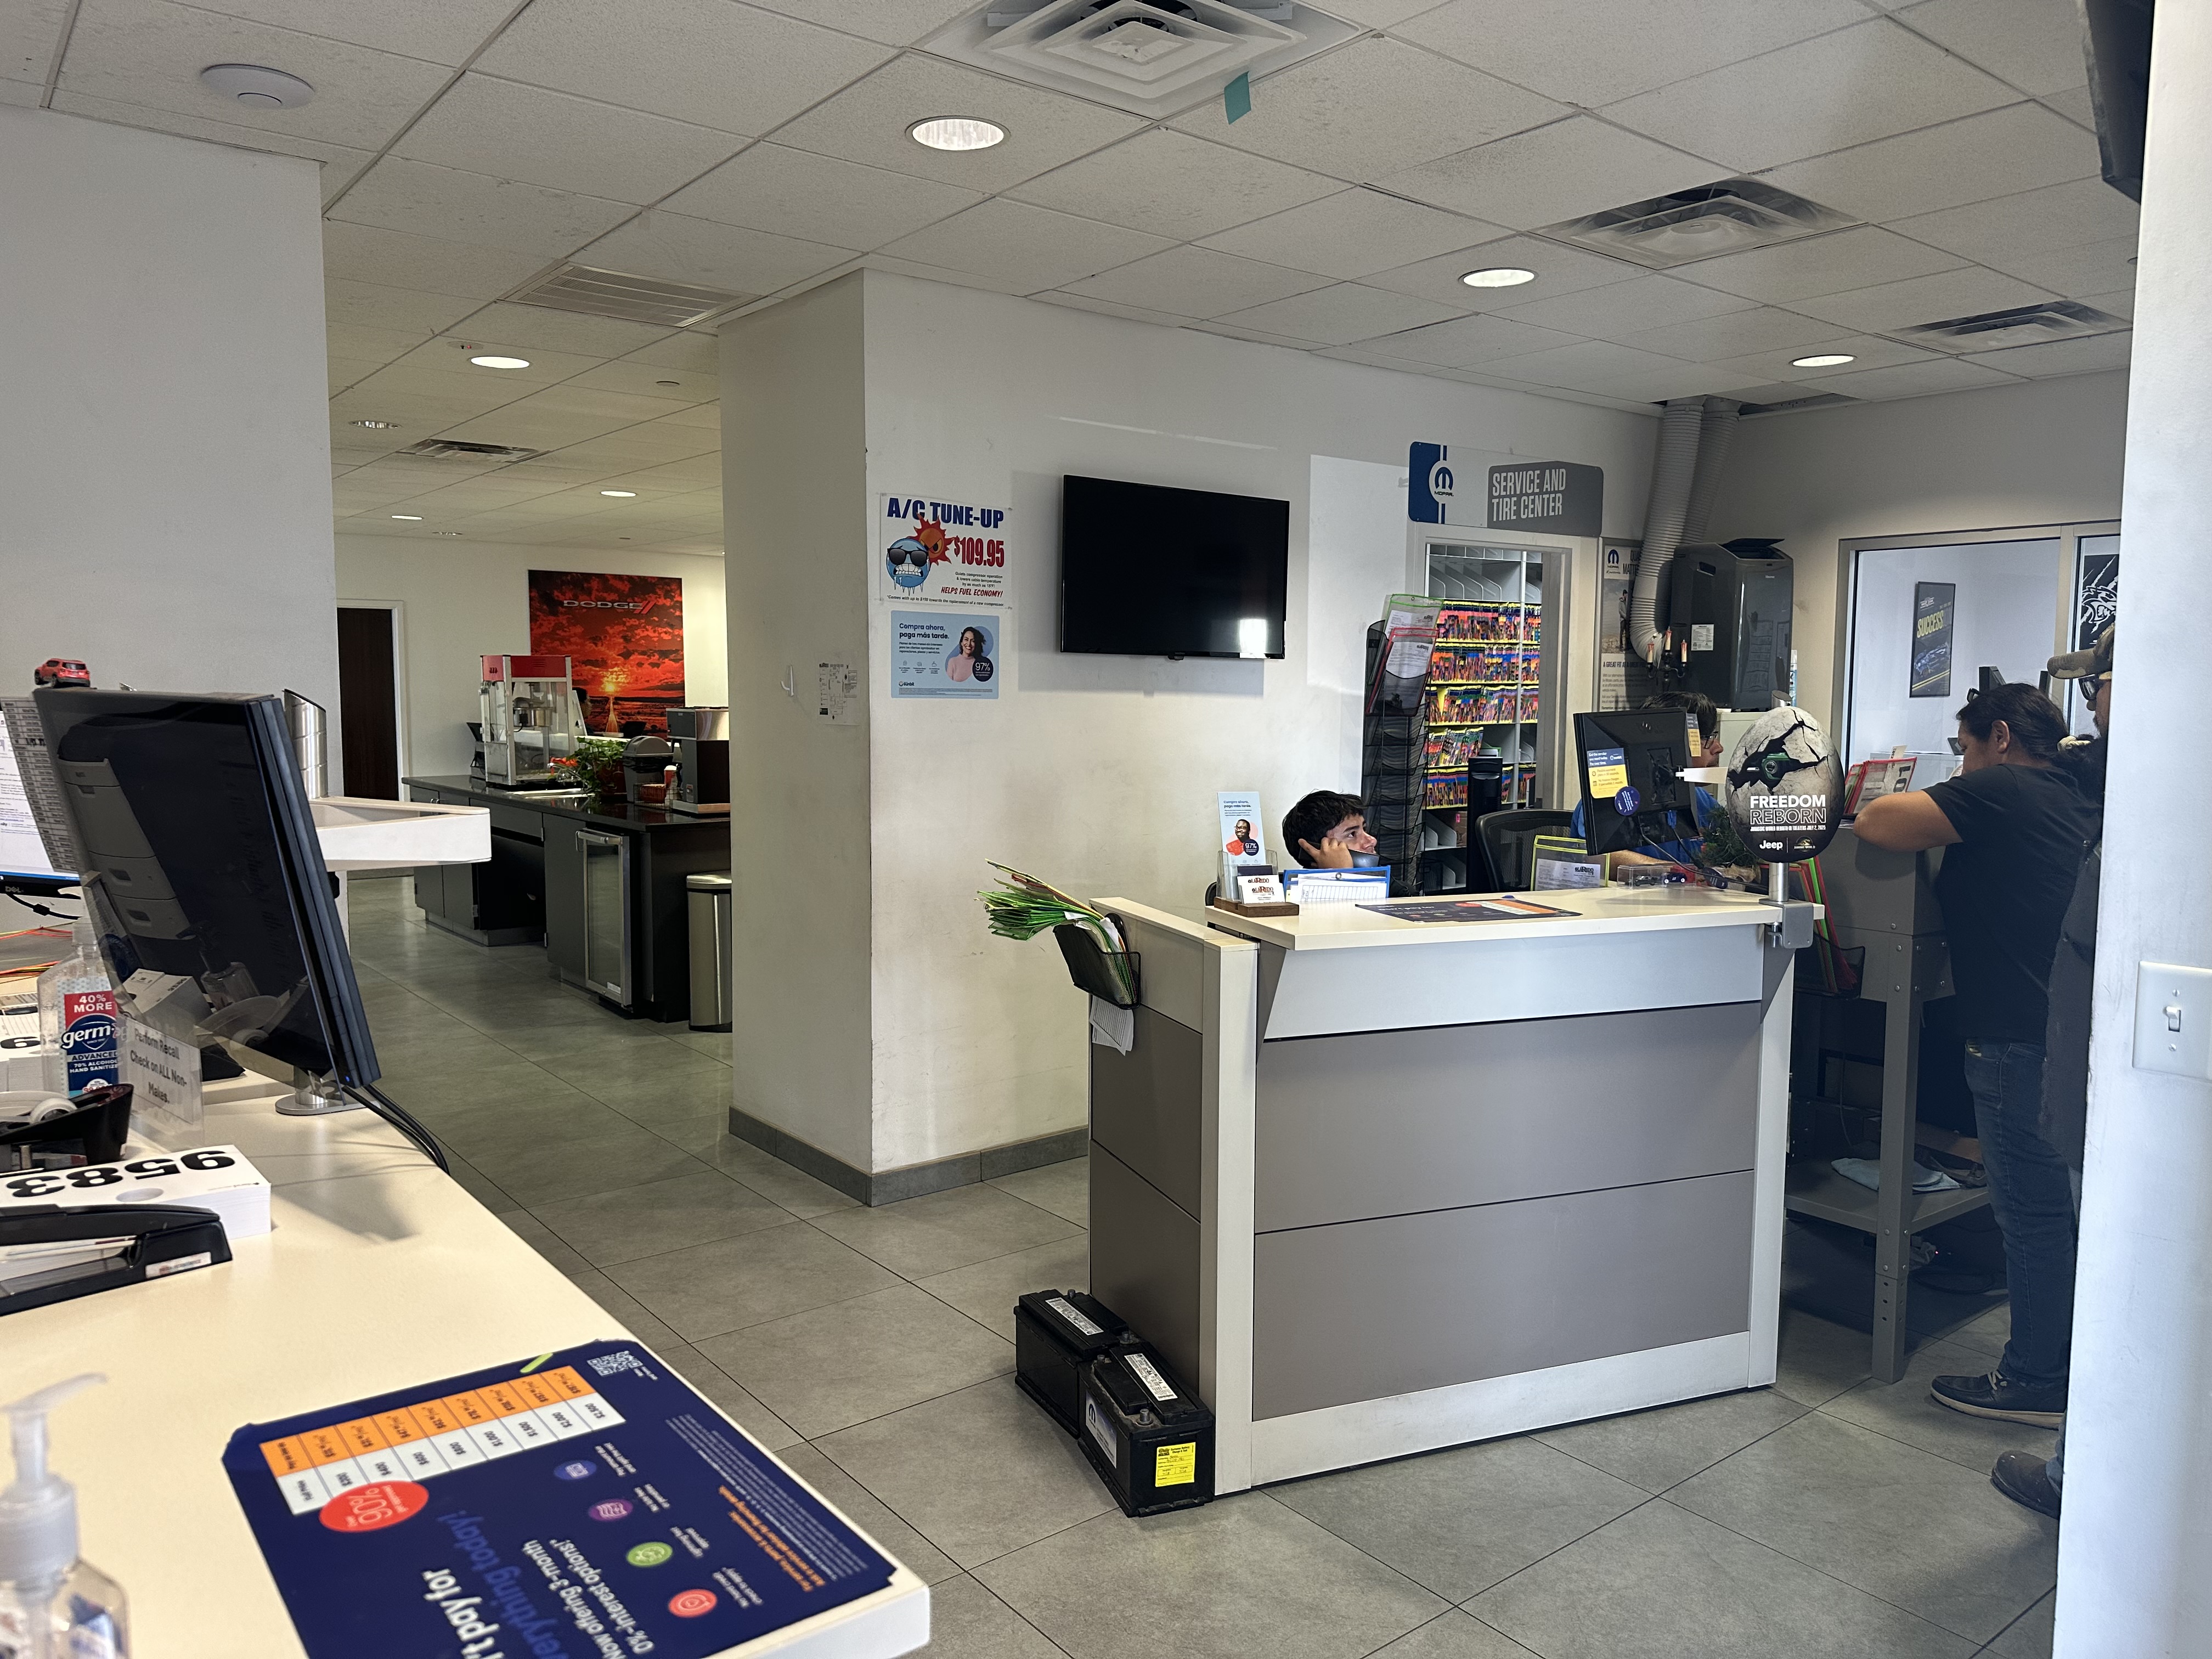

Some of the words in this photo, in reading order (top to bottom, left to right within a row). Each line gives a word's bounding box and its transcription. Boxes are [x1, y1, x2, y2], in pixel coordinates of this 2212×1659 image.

[1493, 470, 1540, 496] SERVICE
[1543, 469, 1566, 492] AND
[887, 498, 926, 520] A/C
[930, 501, 1004, 529] TUNE-UP
[1492, 497, 1516, 521] TIRE
[1520, 493, 1562, 518] CENTER
[954, 535, 1005, 567] $109.95
[941, 586, 958, 595] HELPS
[974, 589, 1003, 597] ECONOMY!
[563, 600, 643, 610] DODGE
[1917, 610, 1944, 637] SUCCESS
[975, 662, 990, 671] 97%
[1750, 794, 1826, 808] FREEDOM
[1750, 808, 1826, 825] REBORN
[1759, 840, 1783, 850] Jeep
[74, 1002, 112, 1013] MORE
[79, 994, 106, 1003] 40%
[134, 1028, 159, 1050] Perform
[160, 1040, 180, 1059] Recall
[72, 1051, 118, 1062] ADVANCED
[131, 1049, 150, 1069] Check
[151, 1062, 159, 1073] on
[159, 1064, 170, 1080] ALL
[171, 1069, 187, 1087] Non-
[148, 1081, 170, 1104] Makes.
[6, 1150, 236, 1198] 9583
[552, 1412, 572, 1427] $2,000
[484, 1431, 503, 1446] $1,000
[449, 1442, 466, 1454] $800
[595, 1446, 605, 1454] due
[413, 1452, 429, 1465] $600
[600, 1453, 618, 1468] amount
[616, 1455, 629, 1465] split
[375, 1462, 391, 1475] $400
[624, 1464, 636, 1472] and
[336, 1472, 352, 1486] $200
[382, 1485, 400, 1505] approved
[645, 1484, 667, 1503] penalties
[348, 1488, 392, 1523] 90%
[438, 1511, 498, 1570] today!
[523, 1541, 568, 1590] 3-month
[424, 1569, 460, 1600] for
[441, 1597, 498, 1640] pay
[560, 1586, 603, 1633] offering
[589, 1583, 652, 1653] 0%-interest
[594, 1633, 625, 1659] Now
